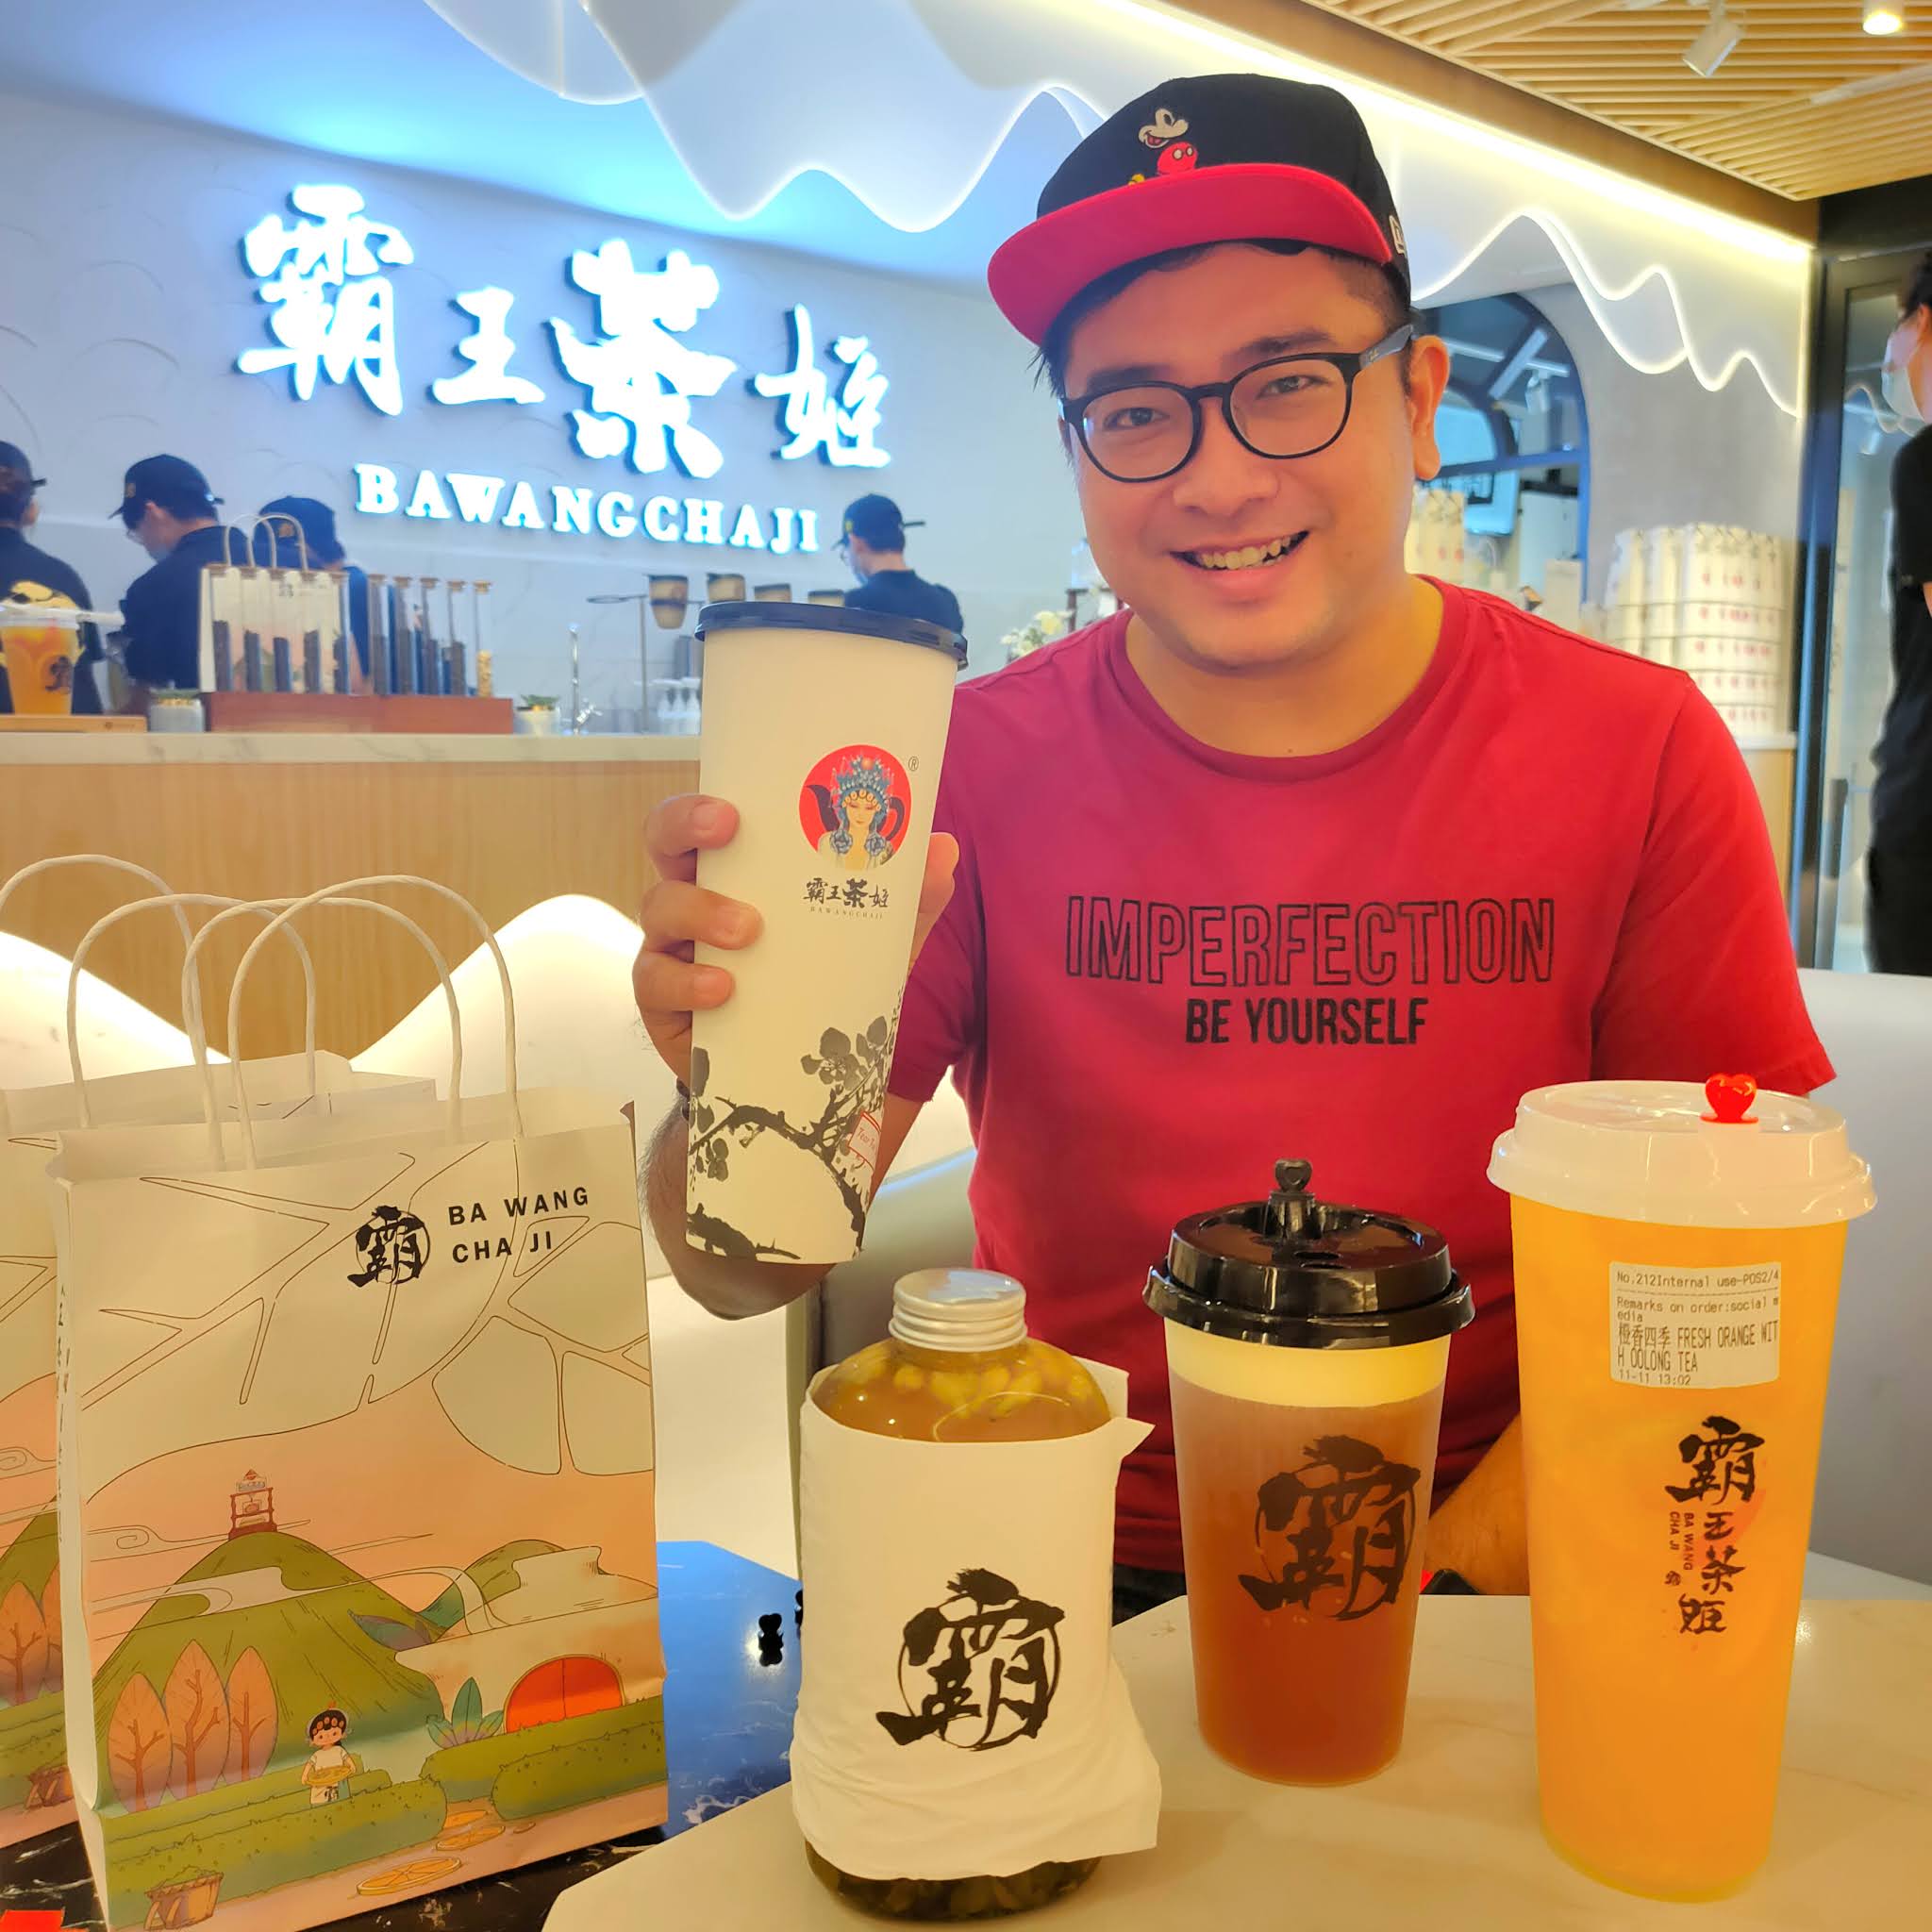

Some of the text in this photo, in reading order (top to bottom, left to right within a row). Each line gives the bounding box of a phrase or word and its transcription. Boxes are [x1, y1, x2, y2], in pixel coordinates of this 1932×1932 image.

[238, 184, 892, 478] 霸王茶姬
[354, 462, 820, 555] BAWANGCHAJI
[803, 877, 890, 909] 霸王茶姬
[1066, 895, 1555, 988] IMPERFECTION
[1185, 996, 1429, 1045] BE YOURSELF
[448, 1187, 589, 1225] BA WANG
[452, 1230, 553, 1263] CHA JI
[1616, 1295, 1663, 1313] Remarks
[1669, 1302, 1685, 1313] on
[1616, 1308, 1643, 1323] edia
[1677, 1320, 1779, 1350] FRESH ORANGE WIT
[1617, 1346, 1698, 1373] H OOLONG TEA
[1618, 1369, 1691, 1386] 11-11 13:02
[1669, 1511, 1680, 1551] CHA JI
[1683, 1512, 1695, 1572] BA WANG
